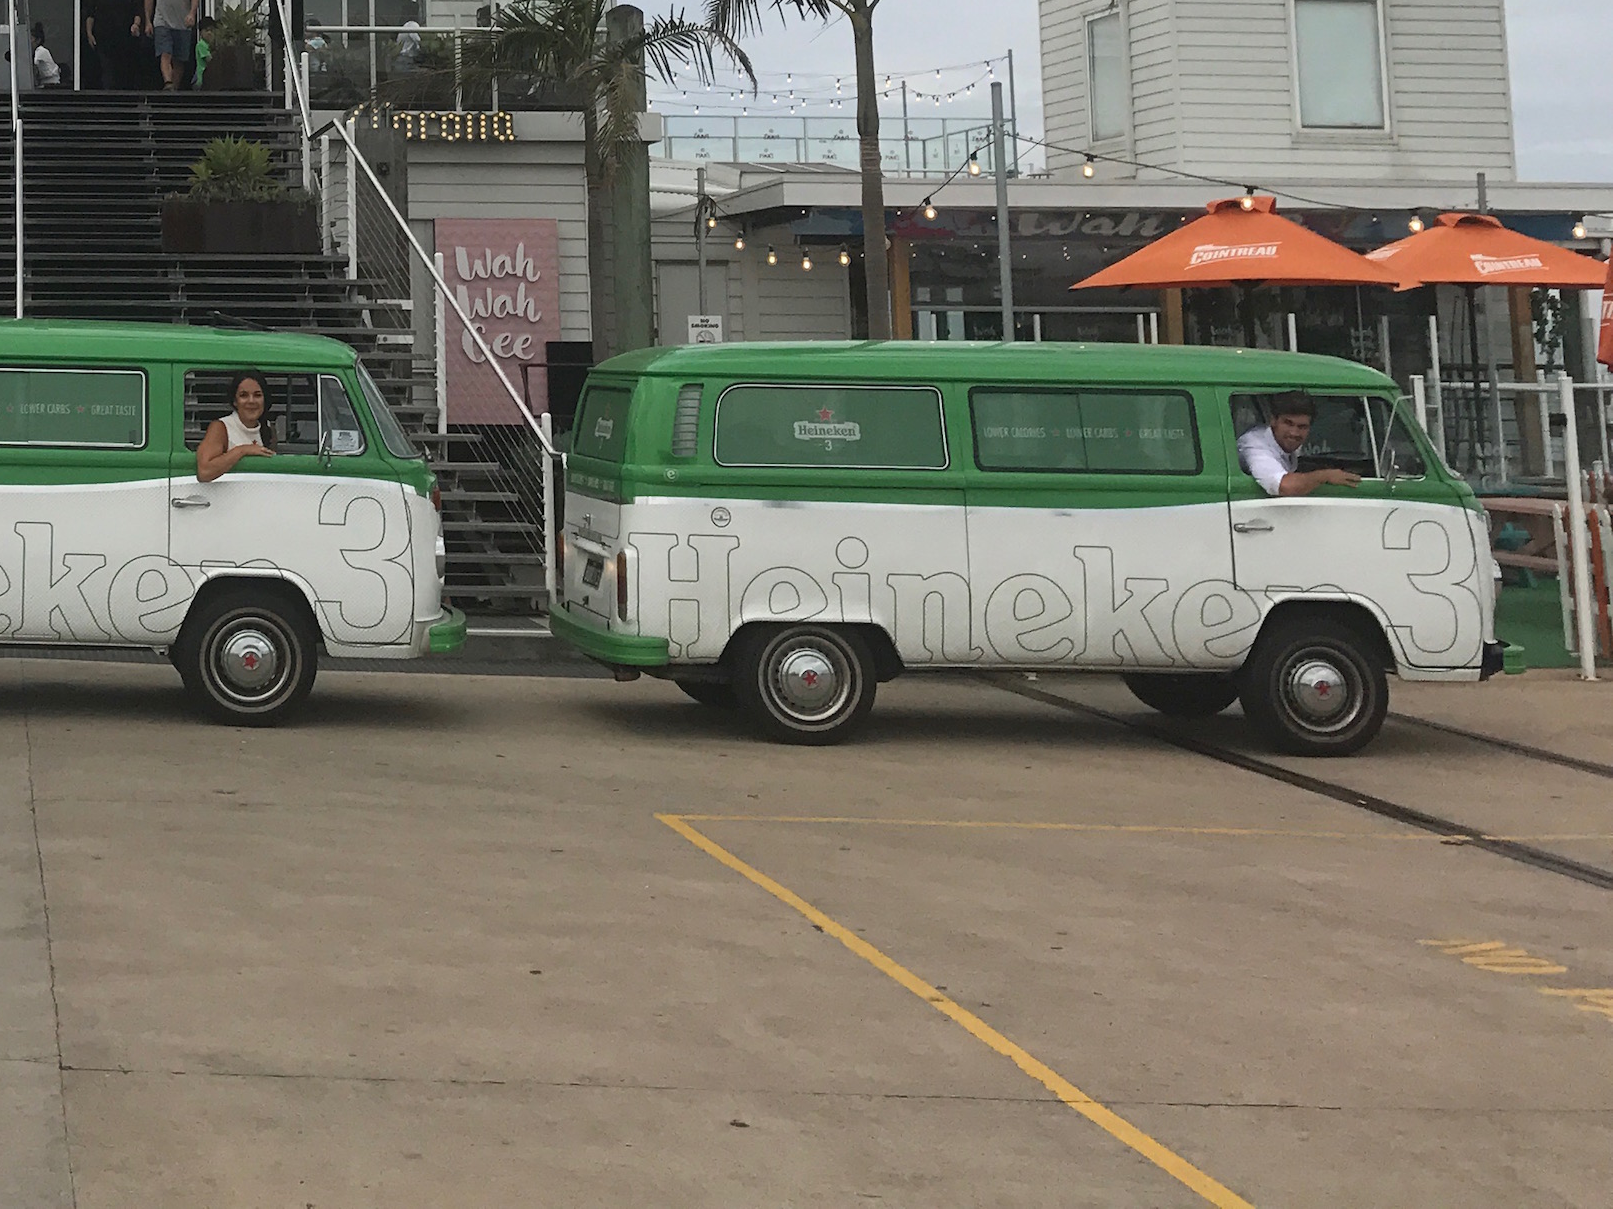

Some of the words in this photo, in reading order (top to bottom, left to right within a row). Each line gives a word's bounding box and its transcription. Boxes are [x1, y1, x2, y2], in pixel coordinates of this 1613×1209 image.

[455, 241, 541, 283] Wah
[1190, 245, 1278, 265] COINTREAU
[456, 282, 542, 323] Wah
[20, 403, 45, 414] LOWER
[47, 403, 71, 415] CARBS
[91, 404, 114, 415] GREAT
[115, 404, 137, 417] TASTE
[797, 424, 857, 437] Heineken
[984, 426, 1009, 438] LOWER
[824, 439, 833, 452] 3
[314, 483, 415, 646] 3
[628, 531, 1354, 667] Heineke
[1380, 507, 1484, 672] 3
